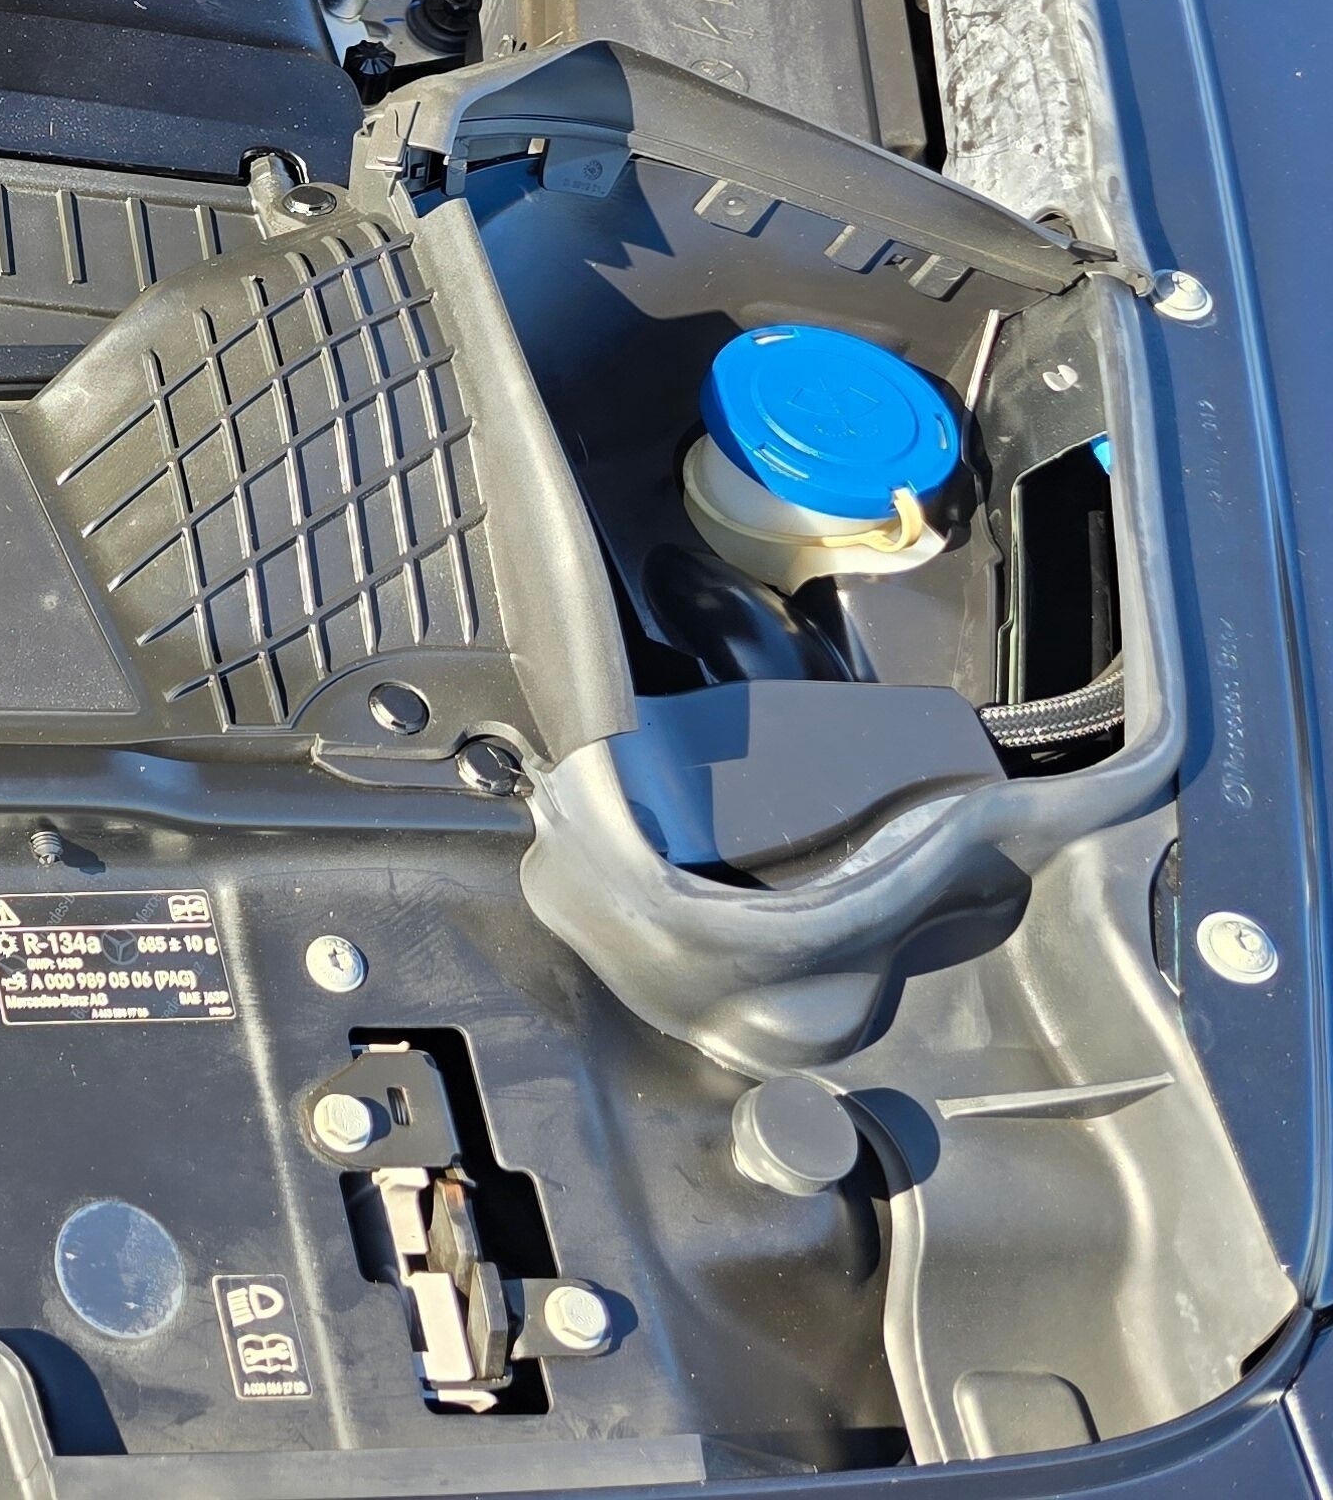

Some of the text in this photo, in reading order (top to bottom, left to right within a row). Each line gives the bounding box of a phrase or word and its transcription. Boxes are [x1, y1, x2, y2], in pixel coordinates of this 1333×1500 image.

[23, 932, 102, 955] R-134a
[137, 935, 167, 953] 685
[183, 935, 203, 952] 10
[205, 937, 218, 955] g
[31, 969, 197, 991] A 000 989 05 06 (PAG)
[5, 992, 108, 1009] Mercedes-Benz AG
